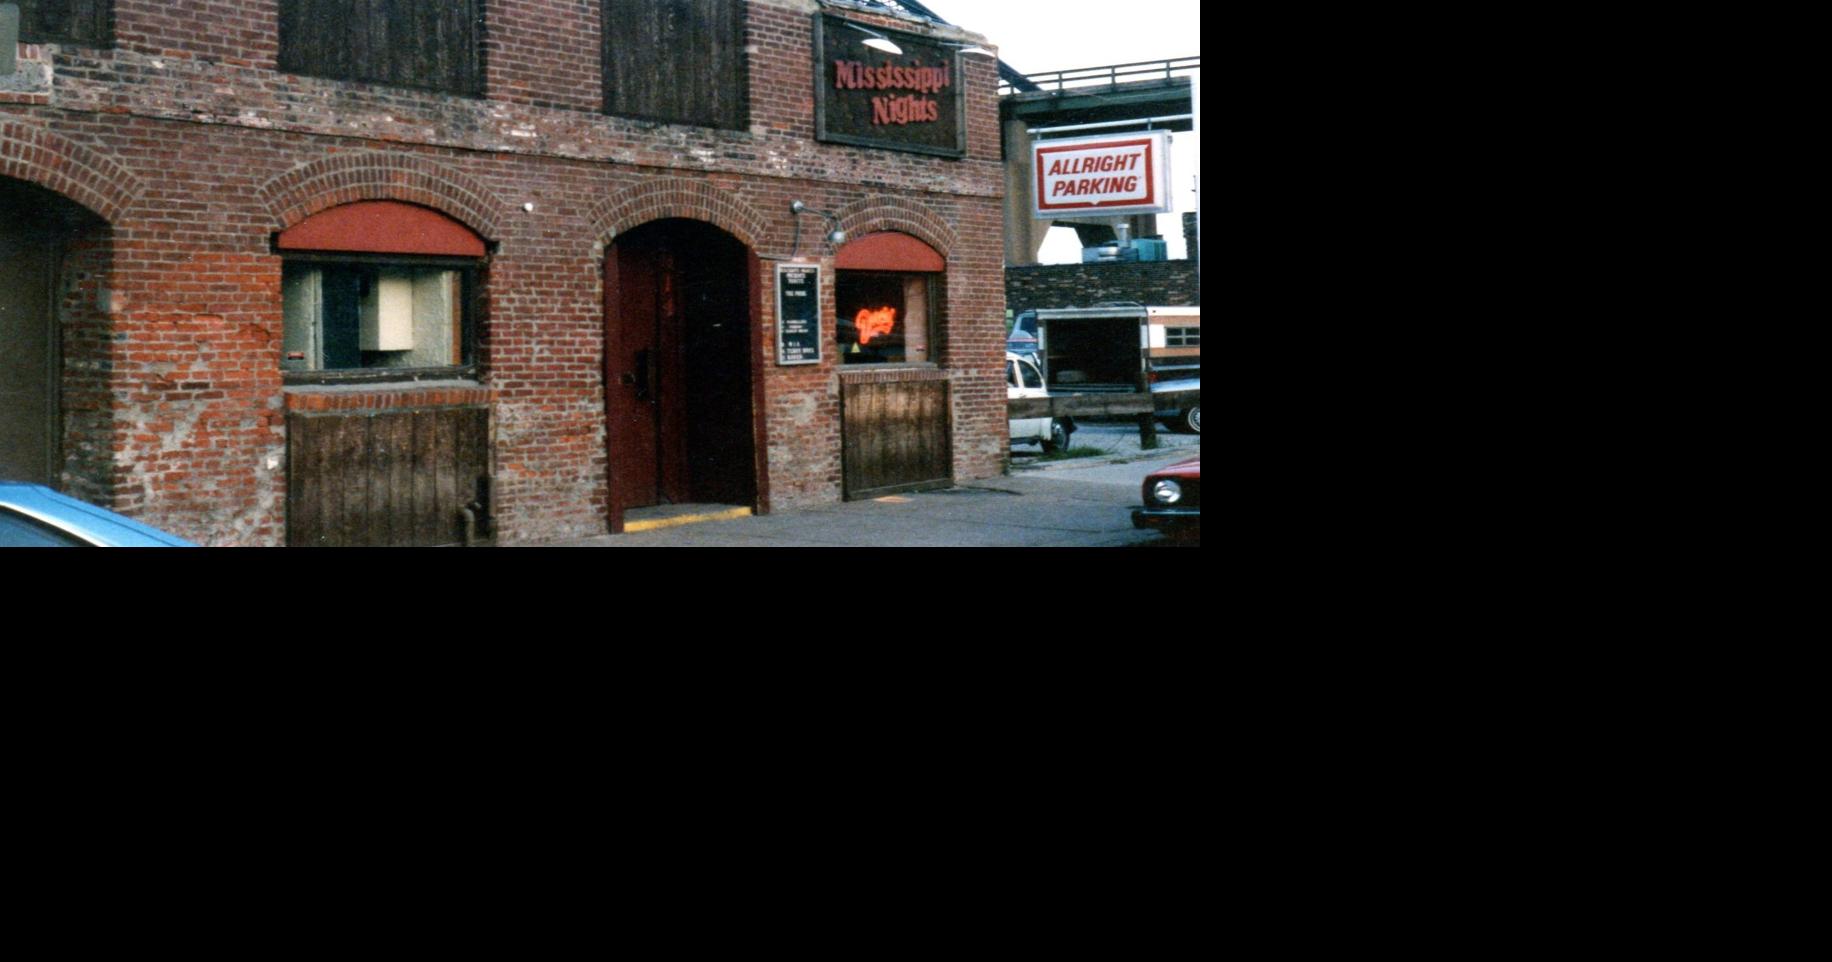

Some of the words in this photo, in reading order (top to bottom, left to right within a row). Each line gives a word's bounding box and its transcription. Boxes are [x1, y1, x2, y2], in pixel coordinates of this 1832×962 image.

[834, 59, 950, 94] Mississippi
[871, 93, 938, 125] Nights
[1048, 153, 1142, 176] ALLRIGHT
[1052, 175, 1138, 197] PARKING
